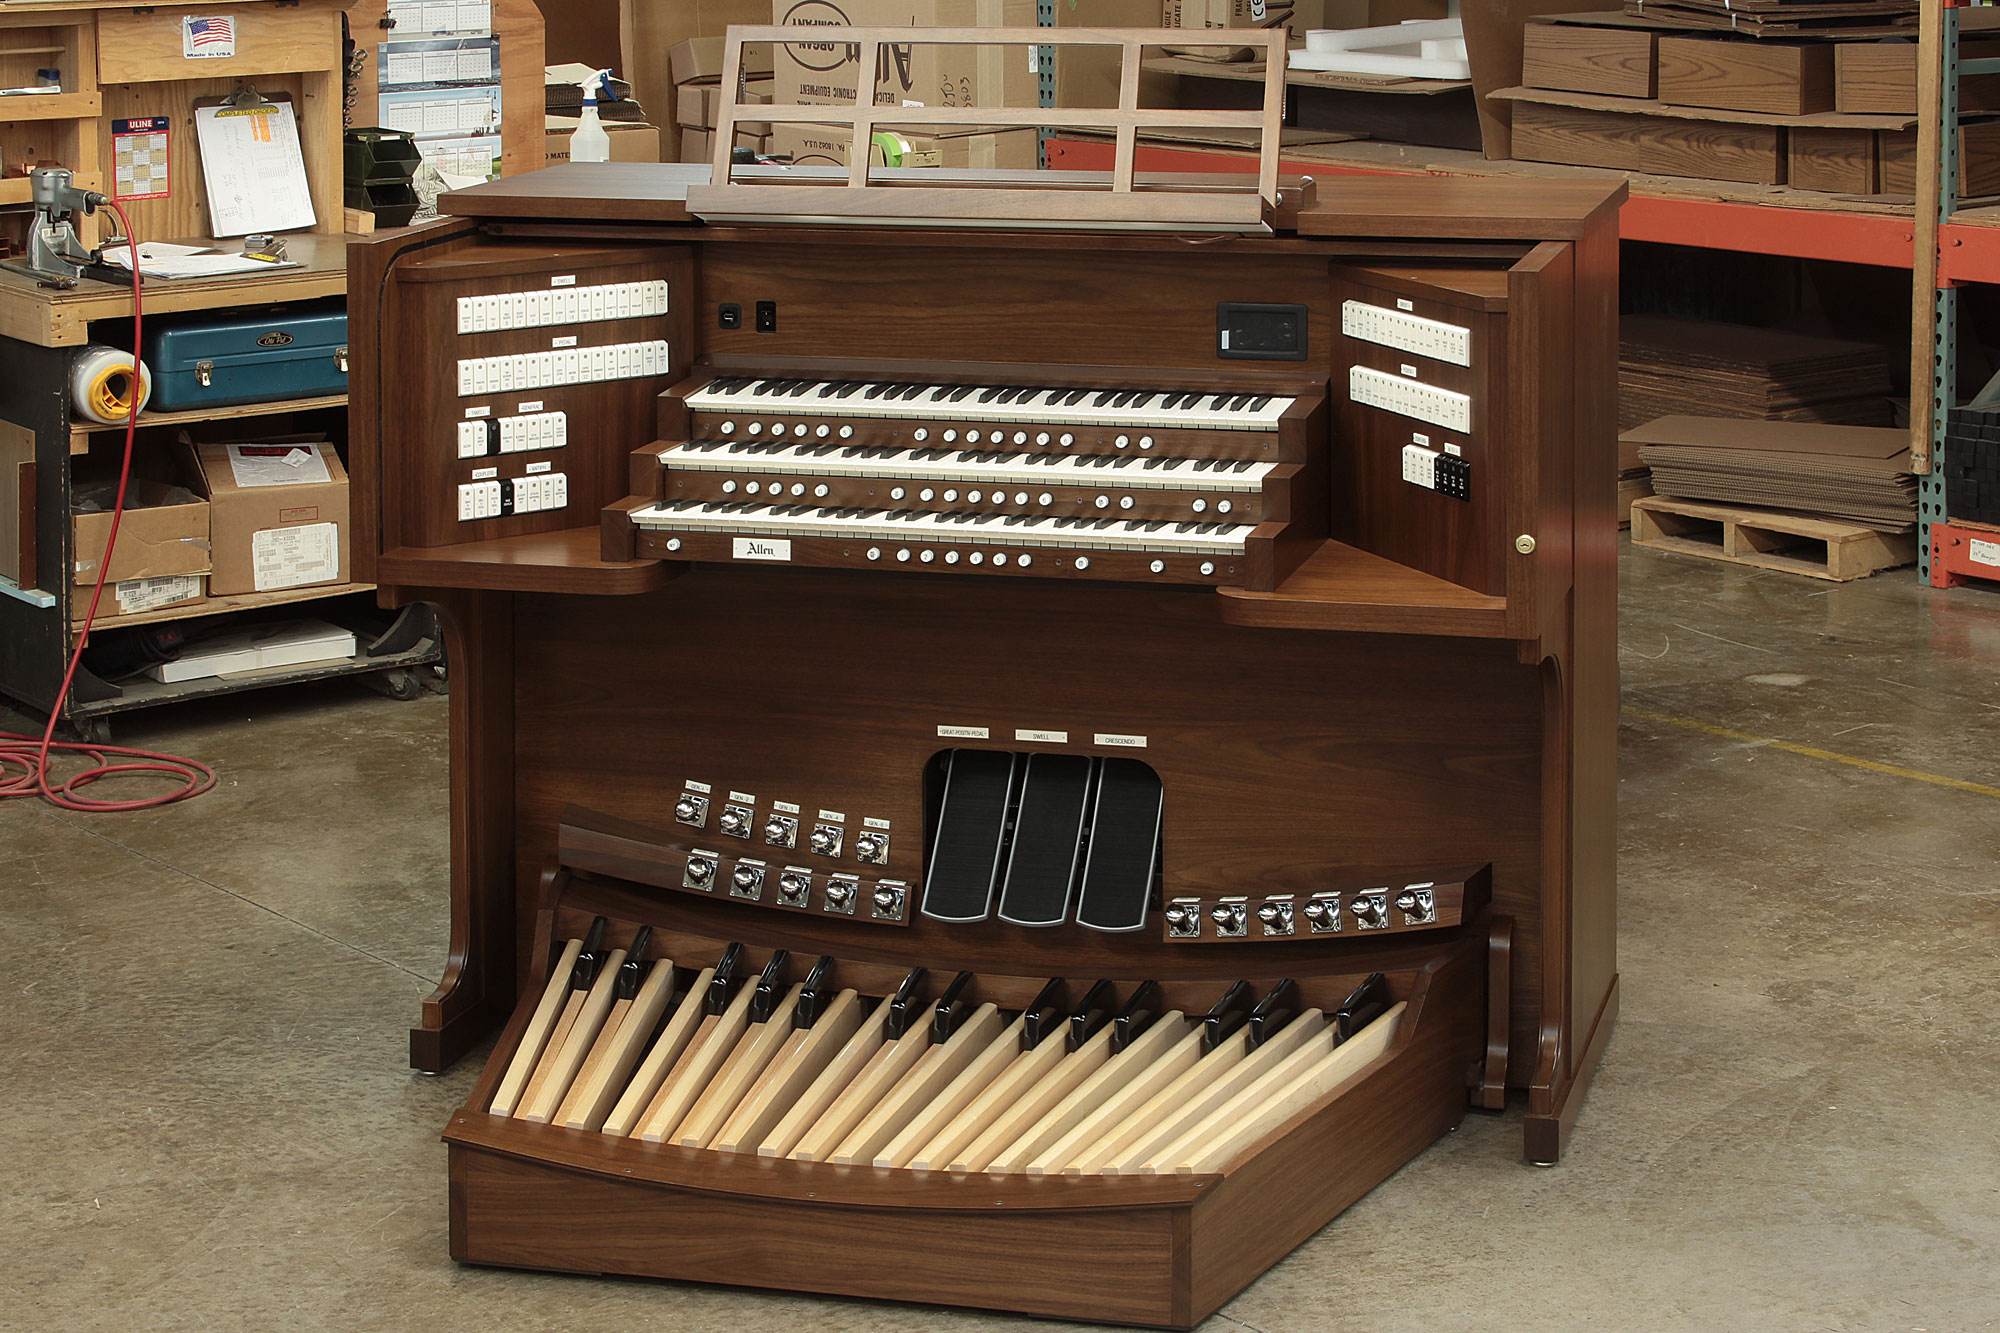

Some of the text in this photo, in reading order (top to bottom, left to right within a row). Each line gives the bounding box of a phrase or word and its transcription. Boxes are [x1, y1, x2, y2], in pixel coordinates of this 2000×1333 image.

[800, 84, 857, 100] CTRONIC EQUIPMENT
[876, 92, 895, 104] DELICA
[129, 120, 153, 128] ULINE
[802, 139, 818, 149] U.S.A.
[819, 142, 834, 151] 18062
[747, 542, 774, 555] Allen
[1105, 737, 1136, 745] CRESCENDO
